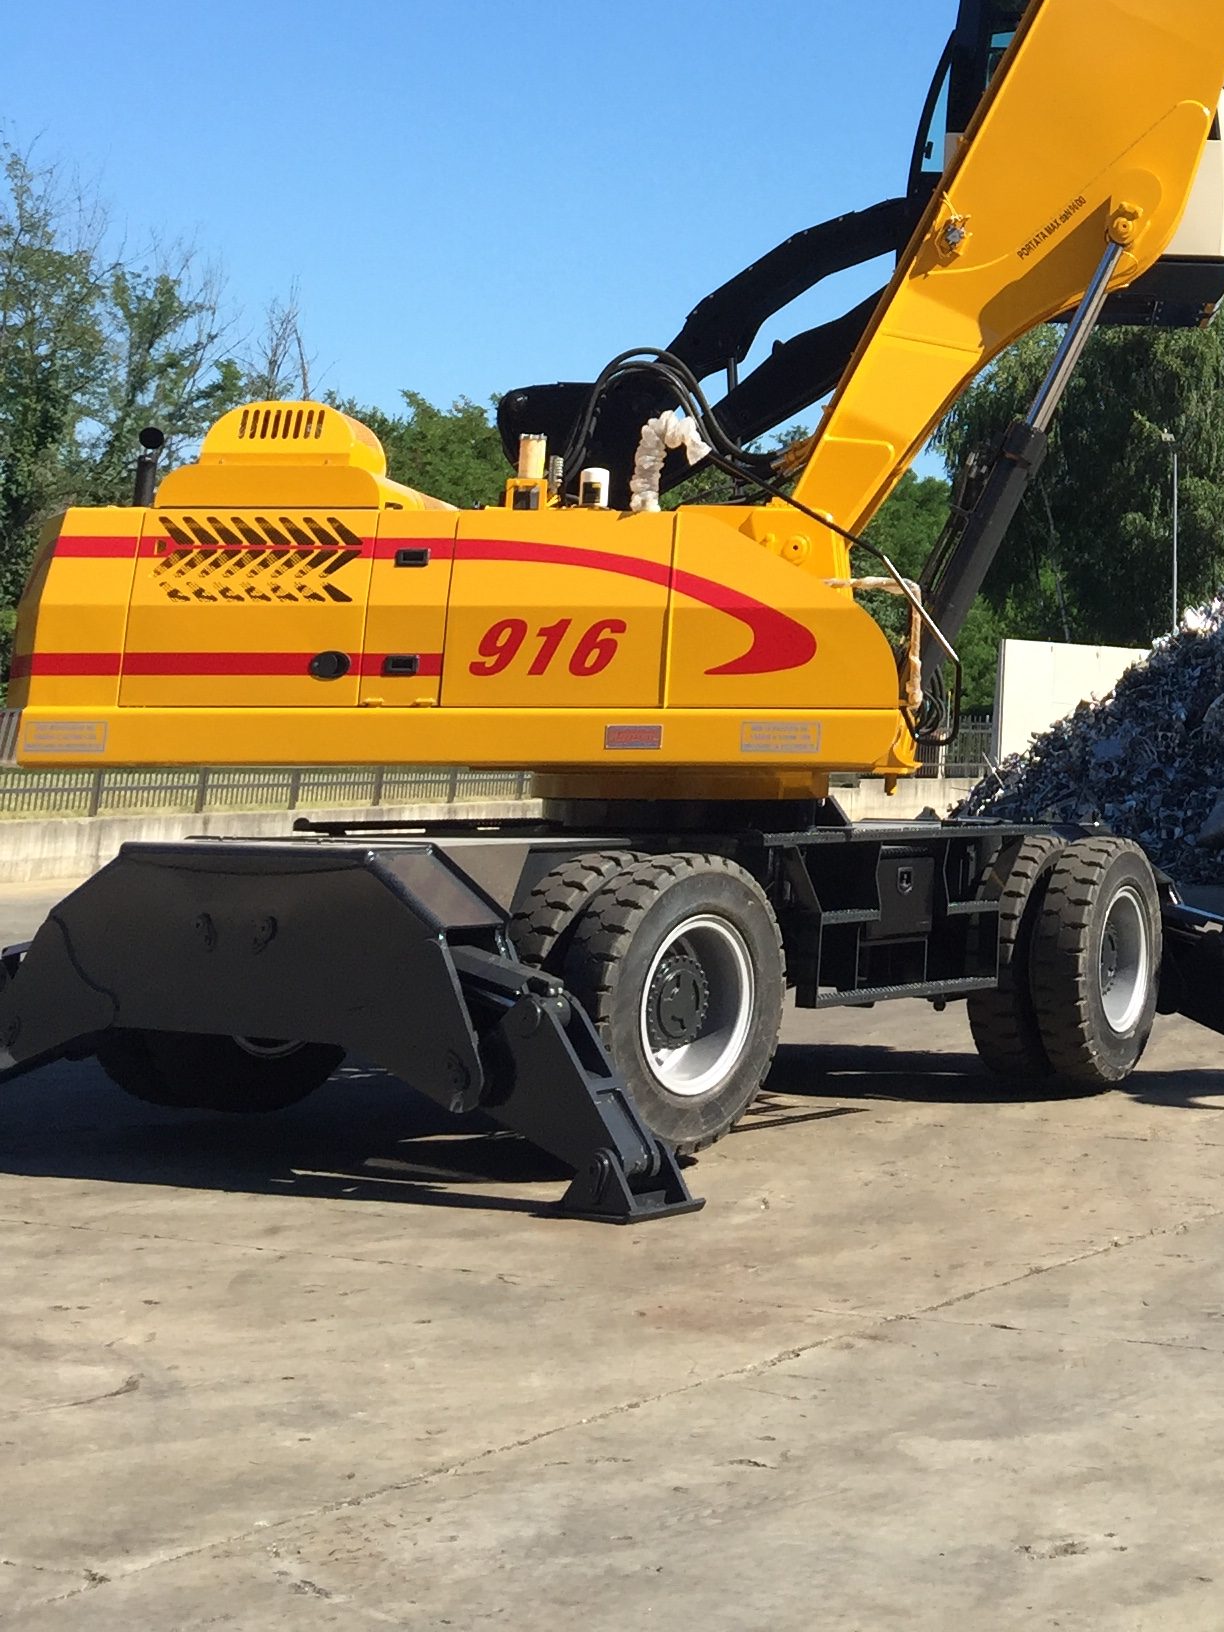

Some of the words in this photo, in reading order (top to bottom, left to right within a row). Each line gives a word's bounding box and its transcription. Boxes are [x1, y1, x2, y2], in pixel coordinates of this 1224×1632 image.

[1016, 231, 1049, 260] PORTATA
[1044, 218, 1061, 235] MAX
[469, 618, 626, 677] 916
